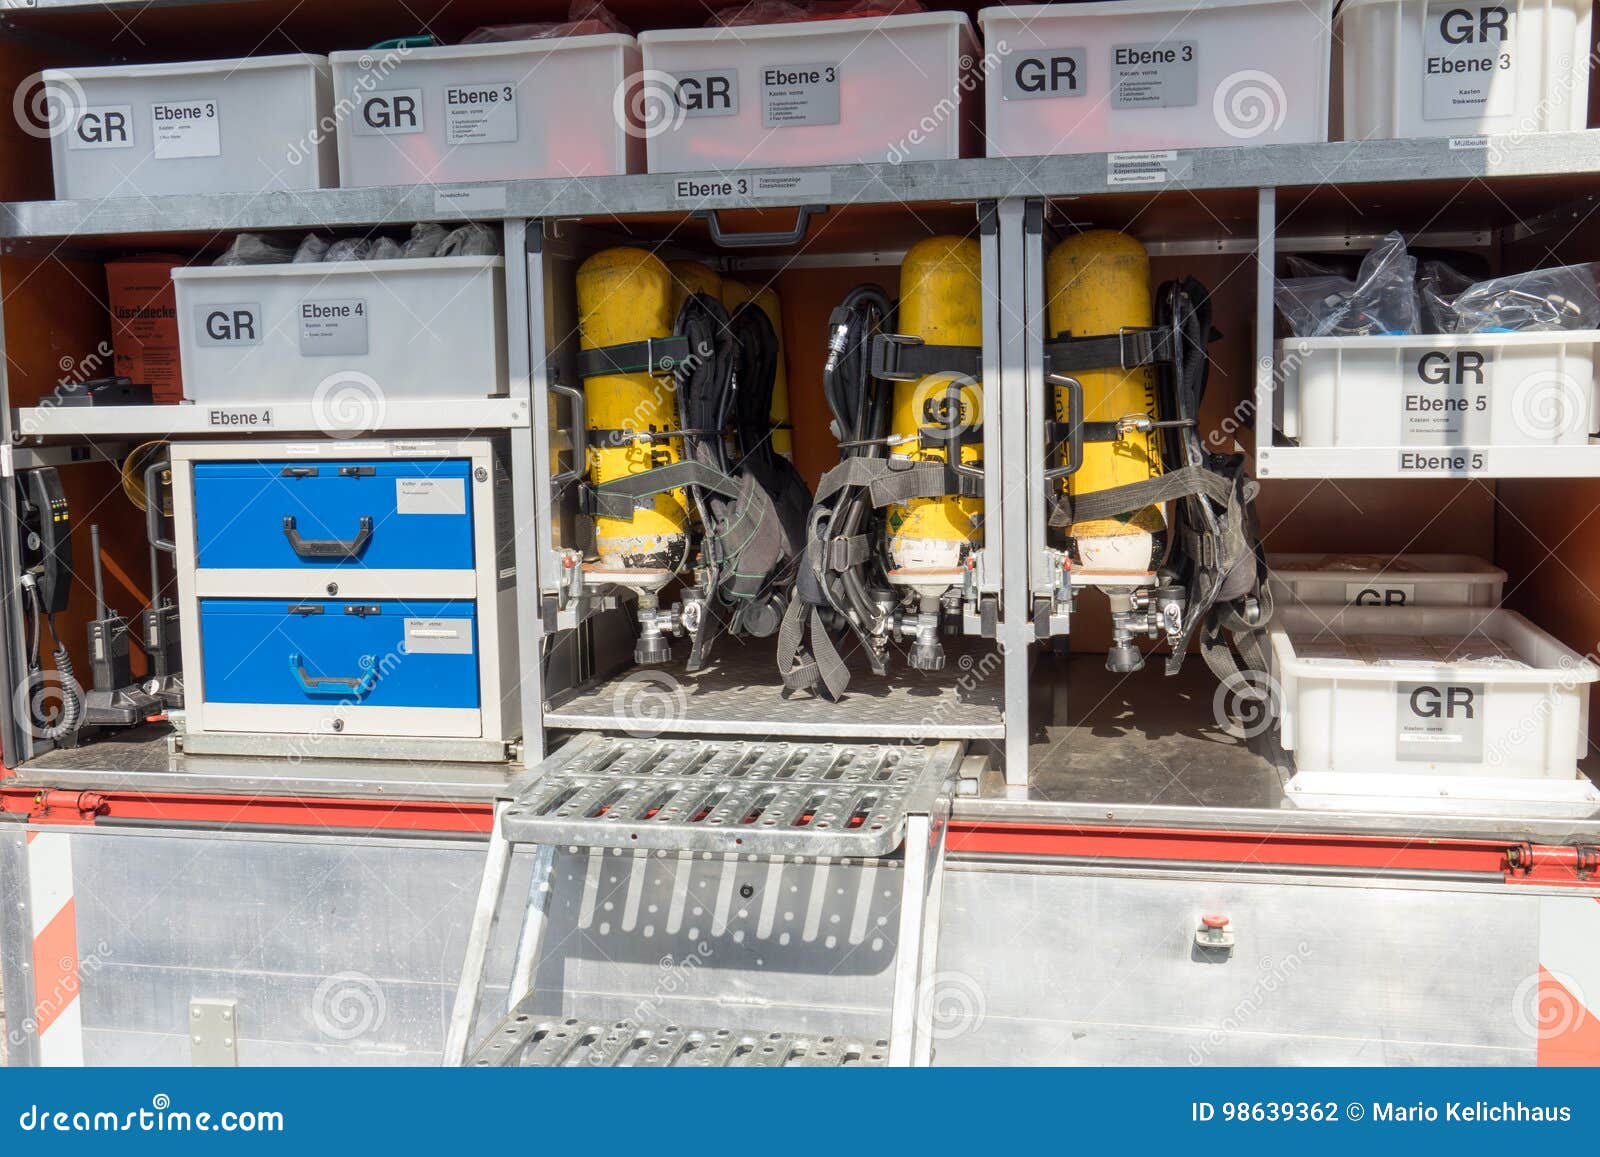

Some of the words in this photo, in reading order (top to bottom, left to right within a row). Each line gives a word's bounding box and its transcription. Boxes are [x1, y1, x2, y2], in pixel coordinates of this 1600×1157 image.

[1440, 6, 1509, 45] GR
[1115, 48, 1175, 65] Ebene
[1182, 45, 1193, 62] 3
[1427, 57, 1493, 73] Ebene
[1499, 54, 1511, 70] 3
[765, 70, 820, 86] Ebene
[825, 67, 836, 83] 3
[1015, 56, 1077, 92] GR
[448, 89, 498, 105] Ebene
[503, 86, 513, 102] 3
[674, 76, 731, 110] GR
[154, 106, 201, 120] Ebene
[206, 103, 215, 118] 3
[363, 95, 417, 128] GR
[77, 111, 127, 143] GR
[677, 182, 732, 197] Ebene
[737, 179, 748, 194] 3
[114, 304, 175, 319] Löschdecke
[302, 304, 350, 318] Ebene
[354, 302, 364, 317] 4
[205, 310, 256, 341] GR
[1417, 351, 1485, 385] GR
[1405, 395, 1469, 411] Ebene
[1475, 395, 1487, 411] 5
[210, 410, 258, 425] Ebene
[261, 410, 271, 425] 4
[1401, 453, 1465, 469] Ebene
[1471, 453, 1483, 469] 5
[1409, 685, 1474, 719] GR
